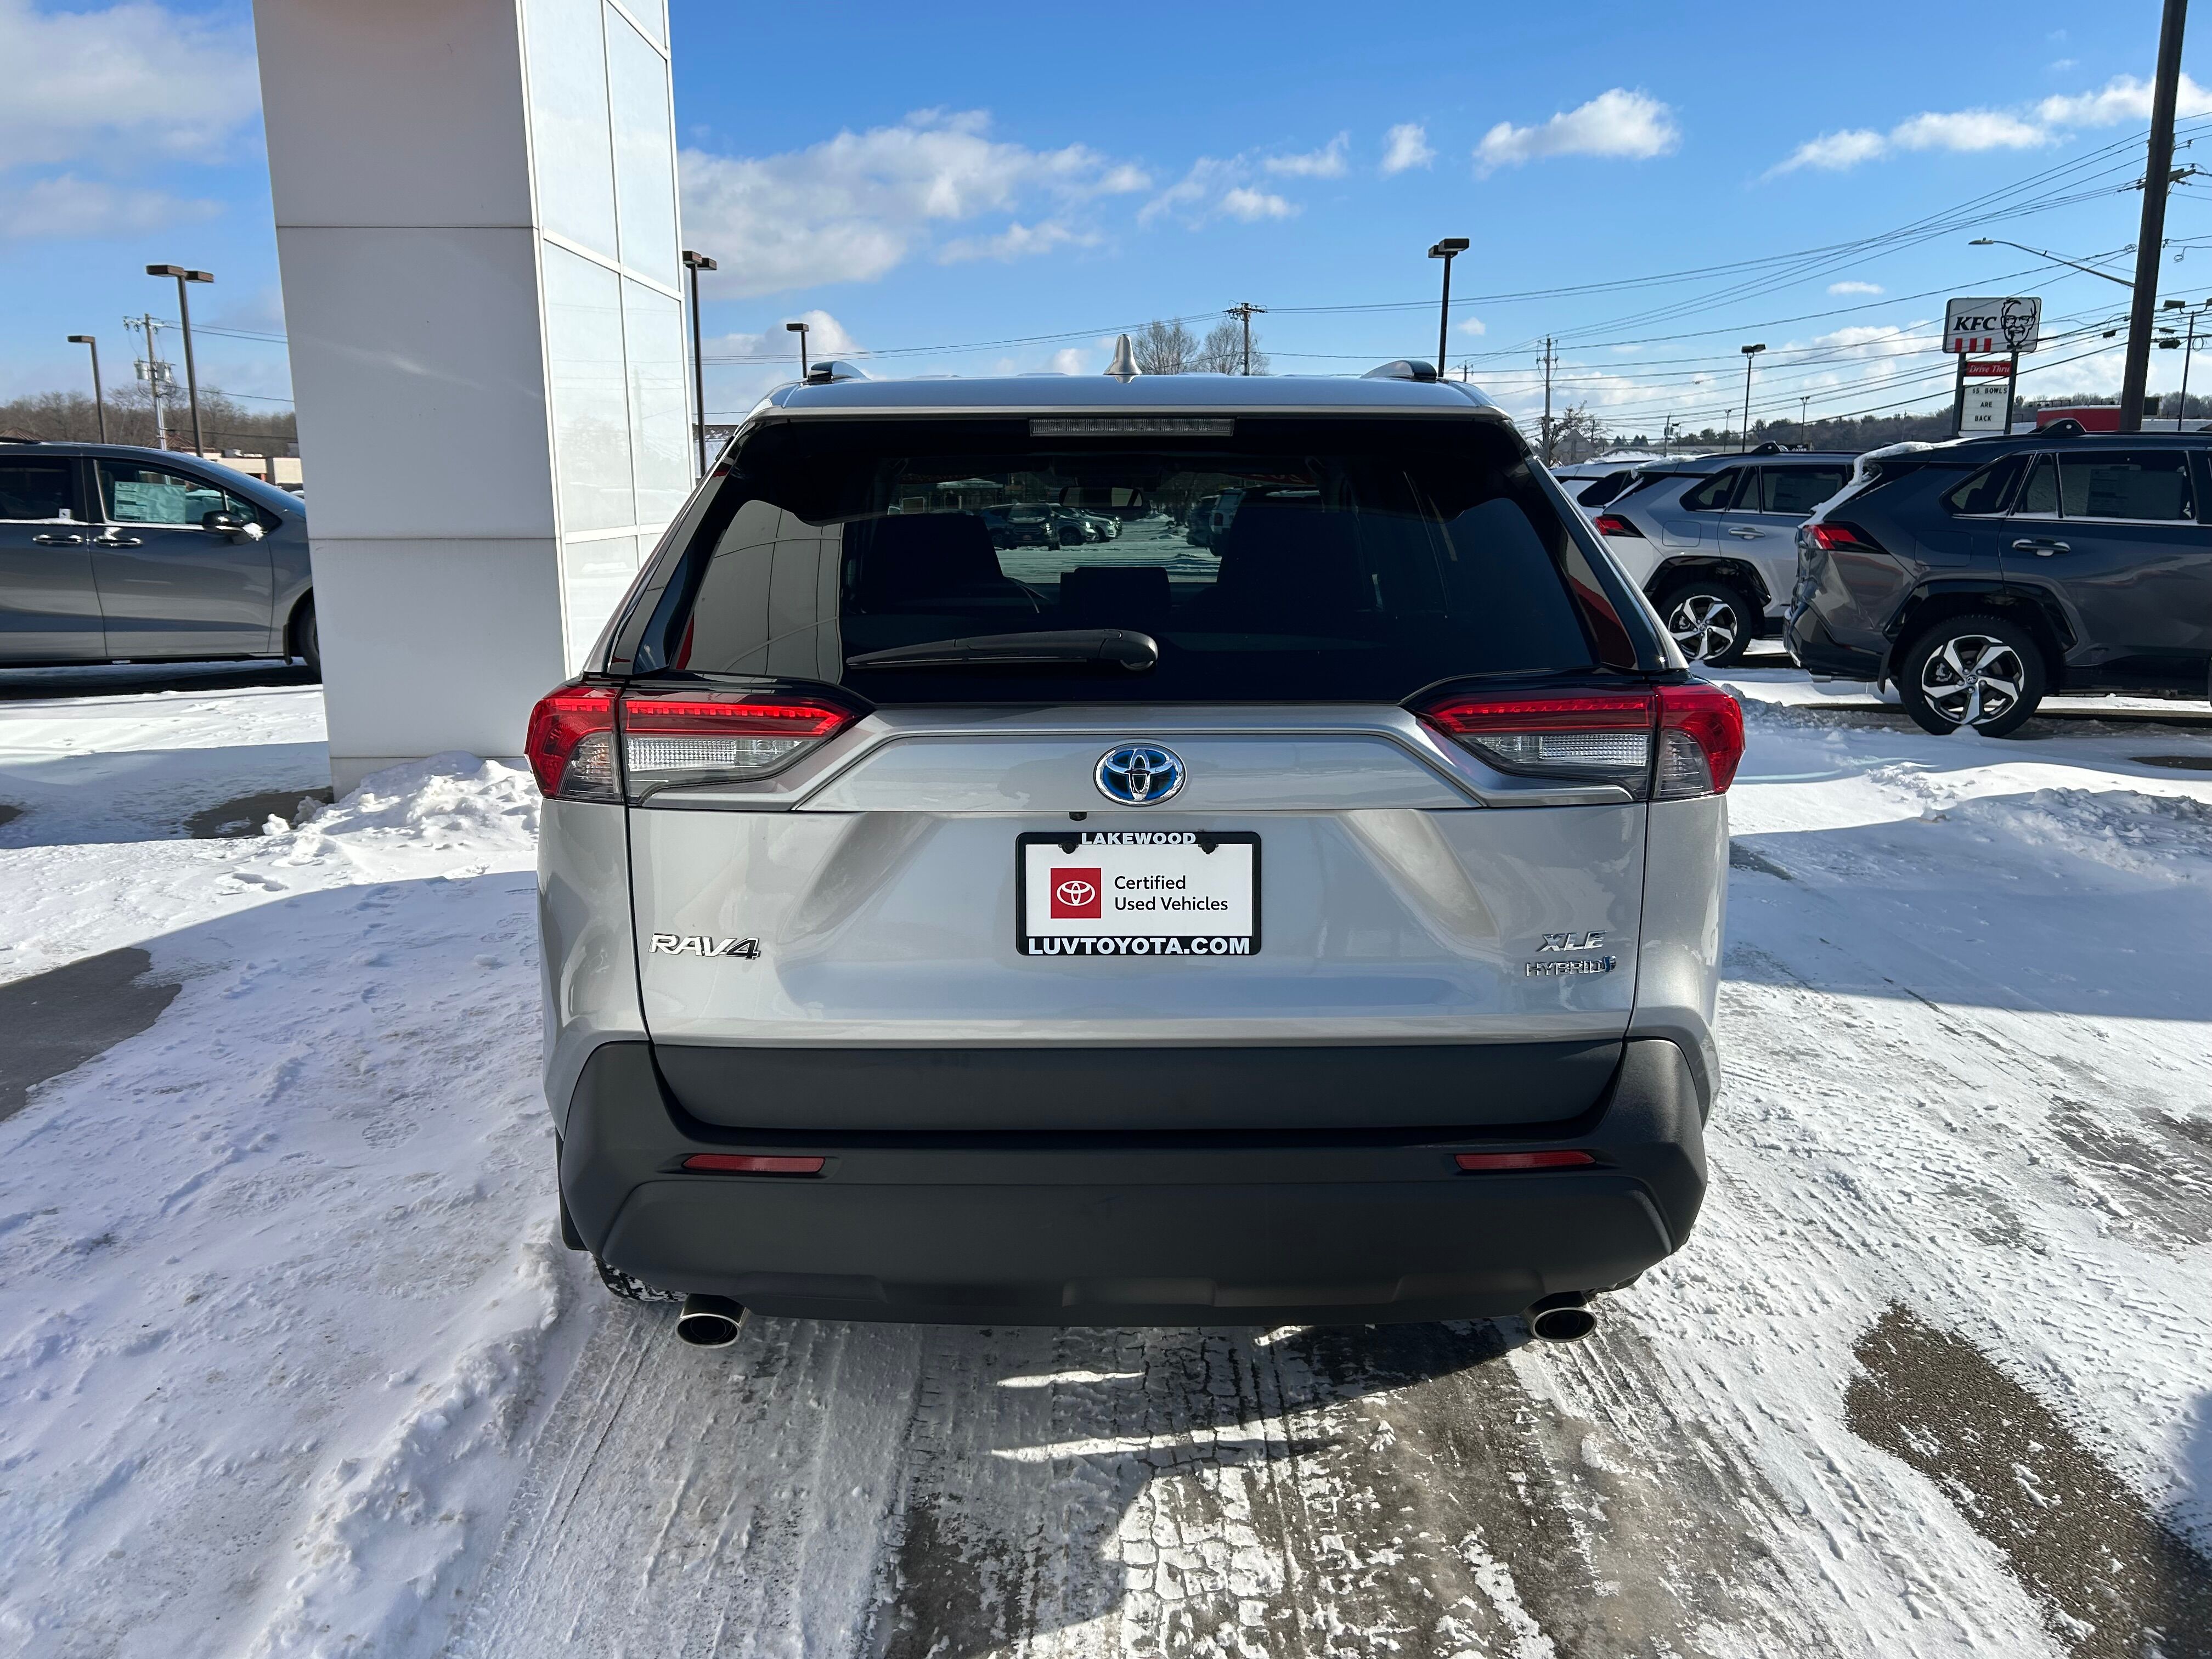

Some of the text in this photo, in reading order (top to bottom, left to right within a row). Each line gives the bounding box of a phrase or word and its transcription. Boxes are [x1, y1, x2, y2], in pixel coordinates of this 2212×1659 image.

[1953, 317, 1996, 330] KFC
[1970, 364, 2011, 373] Drive Thru
[1081, 833, 1197, 845] LAKEWOOD
[1114, 875, 1186, 890] Certified
[1114, 896, 1228, 911] Used Vehicles
[648, 933, 761, 961] RAV4
[1029, 938, 1250, 955] LUVTOYOTA.COM
[1536, 930, 1607, 952] XLE
[1525, 961, 1604, 977] HYBRID
